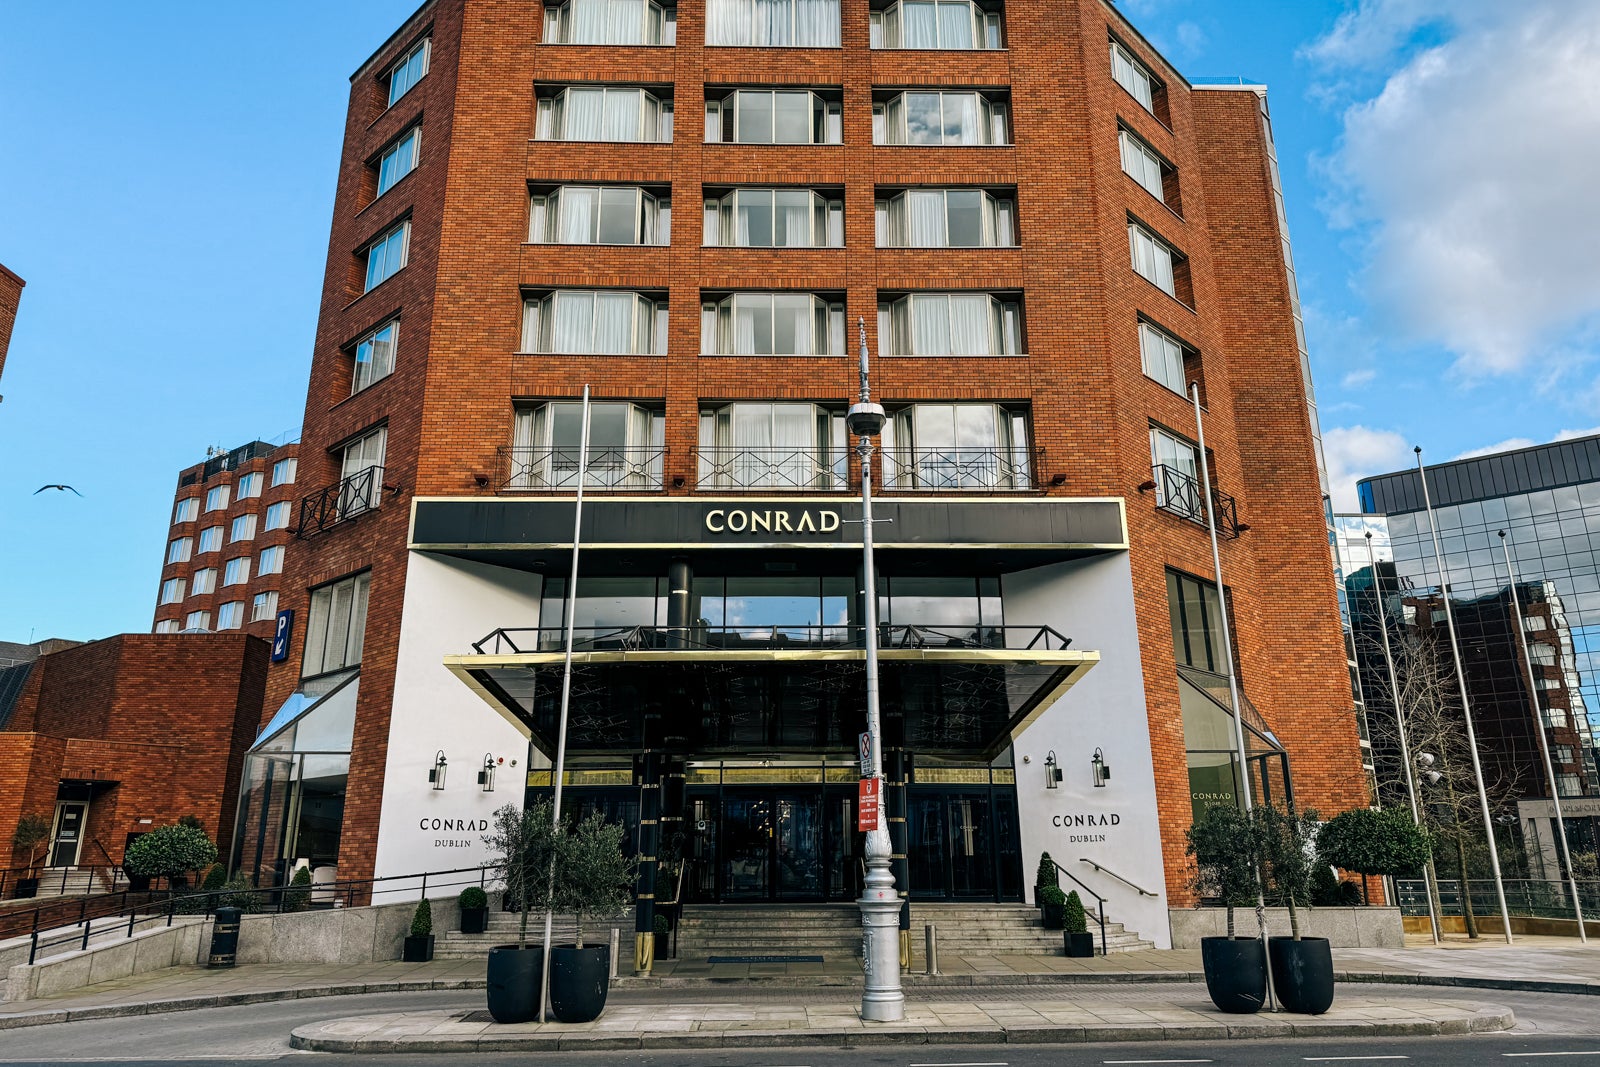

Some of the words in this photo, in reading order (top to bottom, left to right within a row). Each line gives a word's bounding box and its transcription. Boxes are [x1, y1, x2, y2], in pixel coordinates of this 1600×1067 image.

[705, 509, 840, 532] CONRAD
[277, 615, 287, 638] P
[1192, 792, 1232, 800] CONRAD
[419, 817, 489, 832] CONRAD
[1052, 813, 1121, 828] CONRAD
[434, 839, 472, 848] DUBLIN
[1069, 834, 1106, 843] DUBLIN
